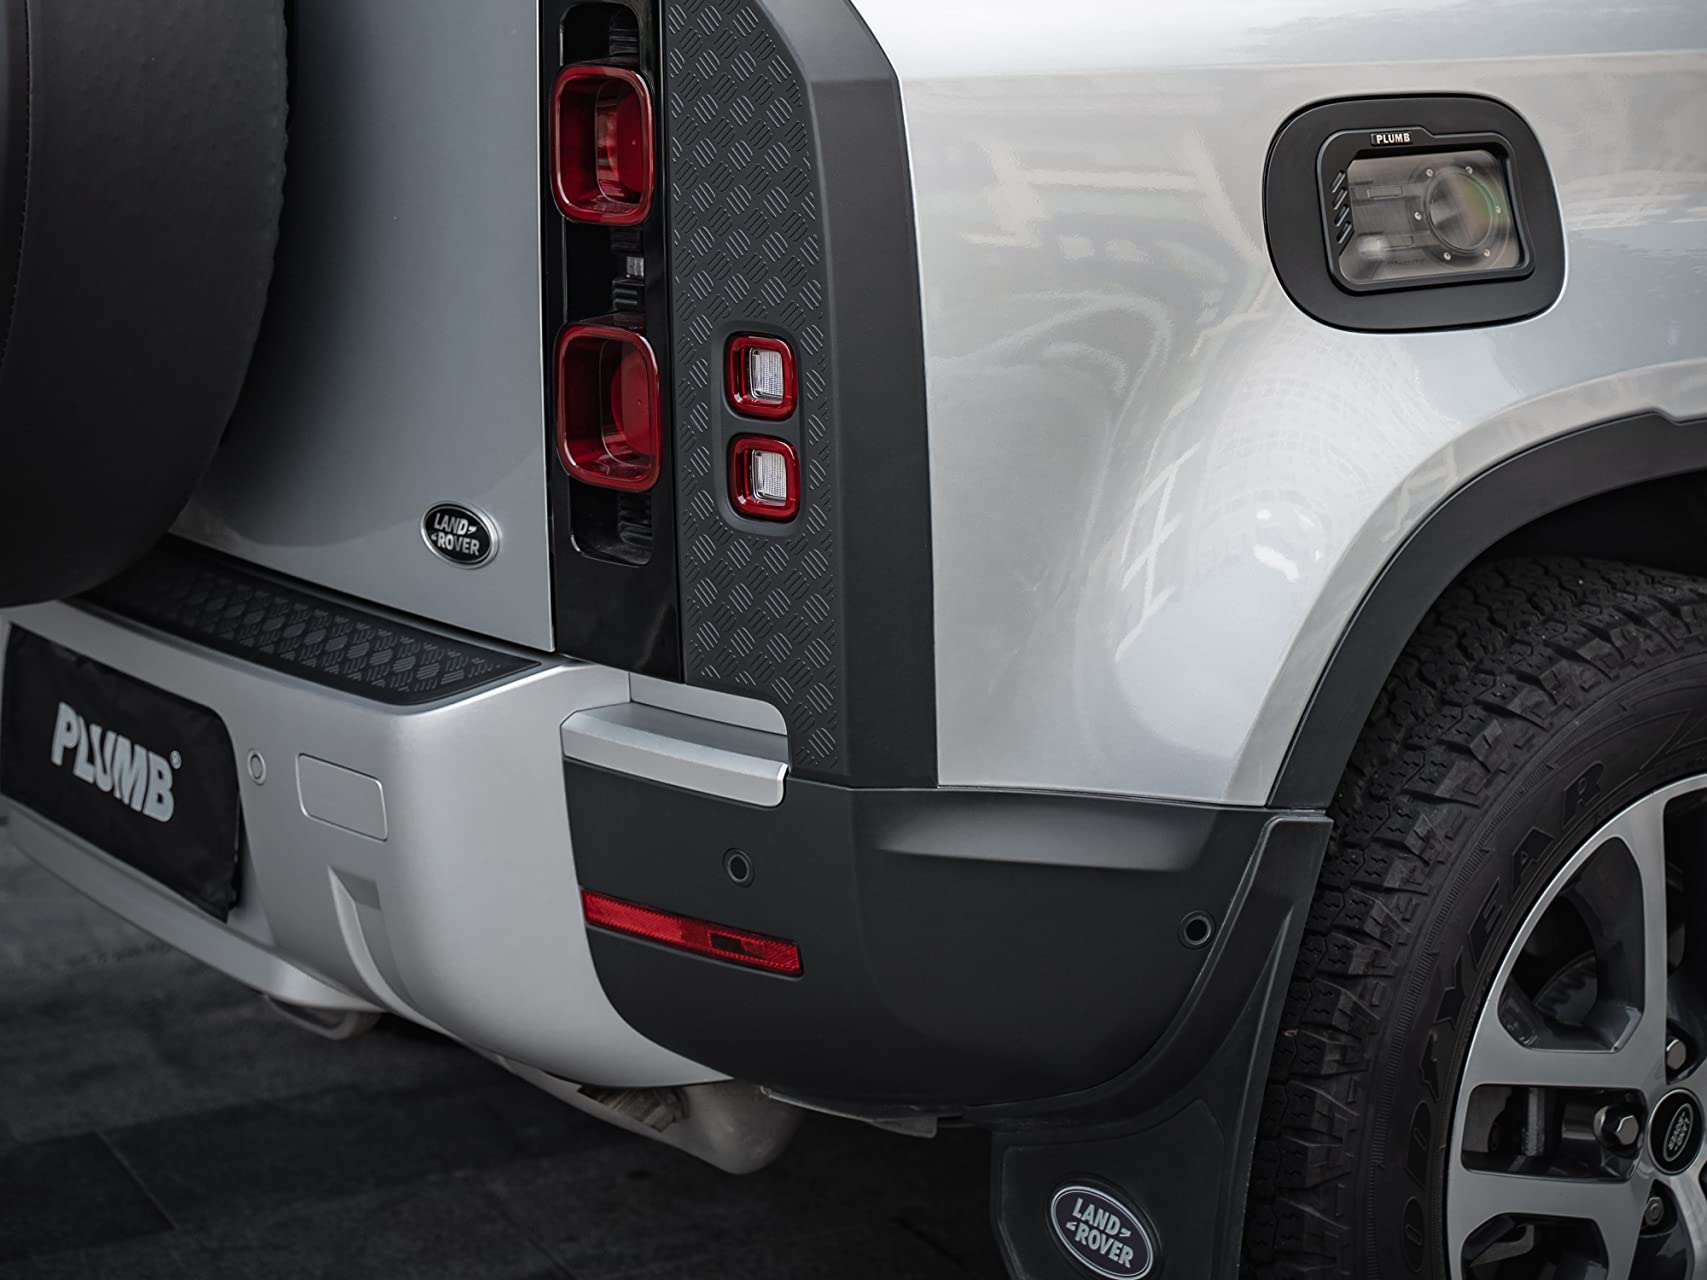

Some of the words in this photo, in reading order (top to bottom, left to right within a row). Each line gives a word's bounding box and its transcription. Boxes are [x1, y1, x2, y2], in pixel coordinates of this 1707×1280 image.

[1376, 132, 1411, 144] PLUMB
[433, 512, 469, 536] LAND
[437, 531, 481, 556] ROVER
[1071, 1197, 1121, 1236] LAND
[1075, 1222, 1134, 1268] ROVER
